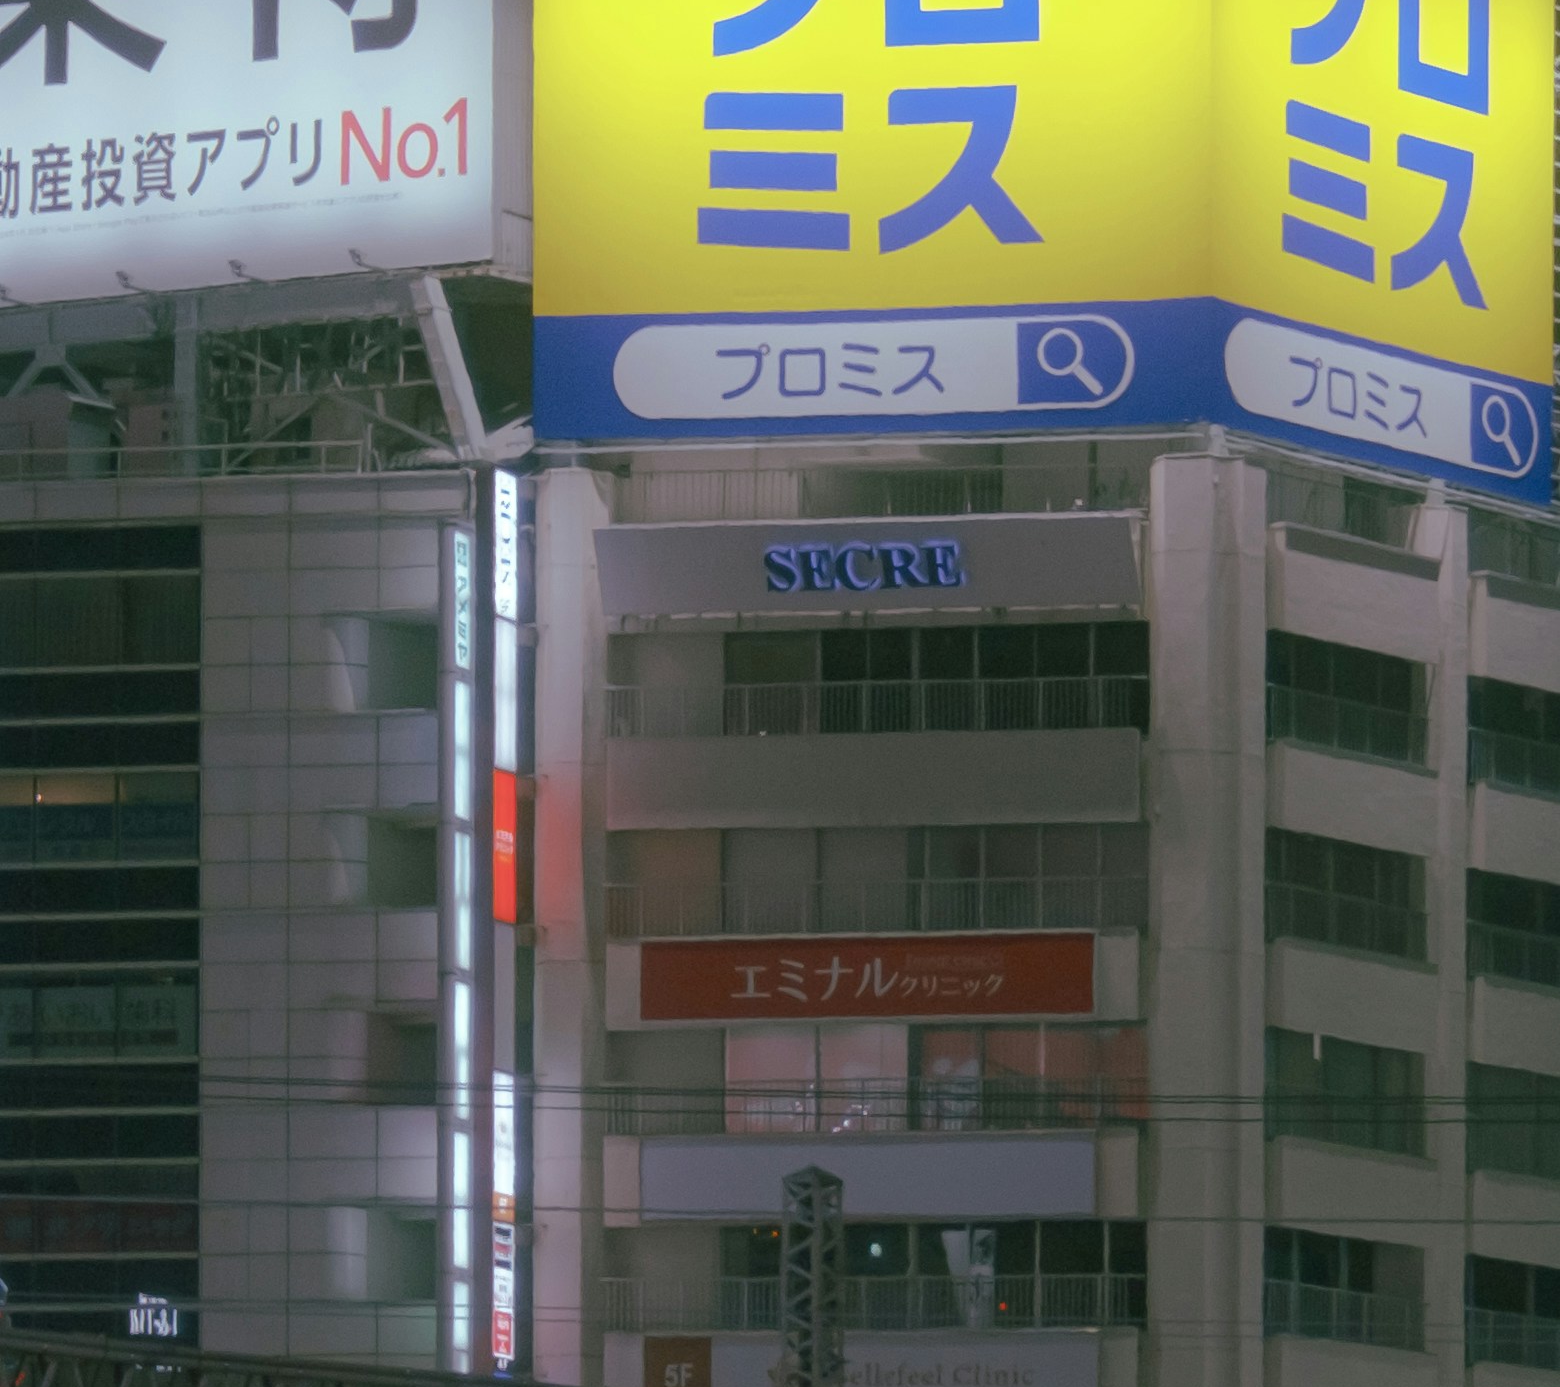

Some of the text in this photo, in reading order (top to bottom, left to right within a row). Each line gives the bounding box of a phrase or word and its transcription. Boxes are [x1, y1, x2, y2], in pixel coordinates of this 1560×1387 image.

[340, 97, 470, 187] No.1
[697, 84, 1044, 255] ミス
[1281, 99, 1488, 310] ミス
[715, 342, 945, 402] プロミス
[1289, 355, 1428, 437] プロミス
[763, 539, 966, 592] SECRE
[836, 1362, 943, 1387] ellefeel
